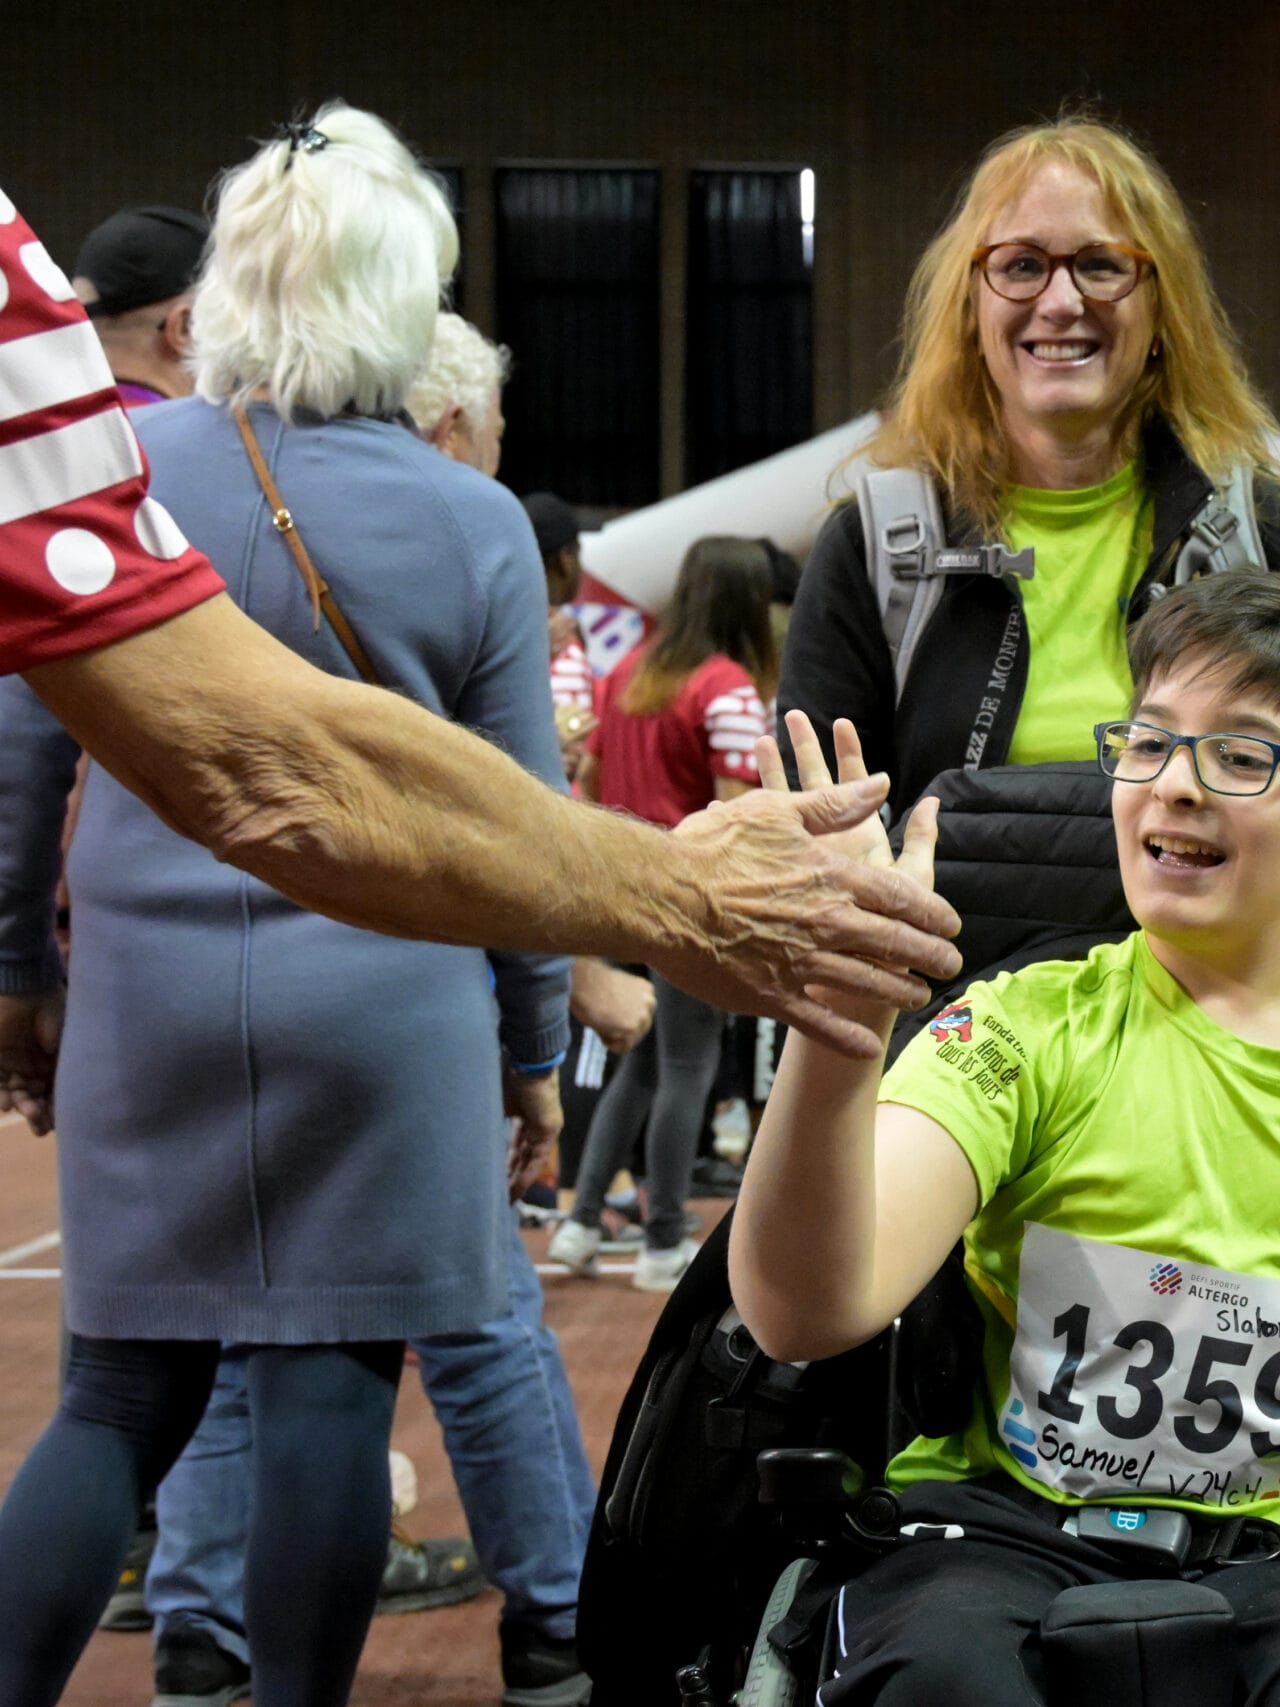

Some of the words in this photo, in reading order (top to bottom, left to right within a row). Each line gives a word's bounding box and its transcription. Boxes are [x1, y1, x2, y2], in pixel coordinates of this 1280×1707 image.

[975, 696, 1000, 729] DE
[936, 1038, 965, 1065] tous
[967, 1067, 1003, 1101] jours
[974, 1038, 1008, 1073] Héros
[1000, 1064, 1021, 1086] de
[1188, 1284, 1249, 1308] ALTERGO
[1037, 1423, 1155, 1487] Samuel
